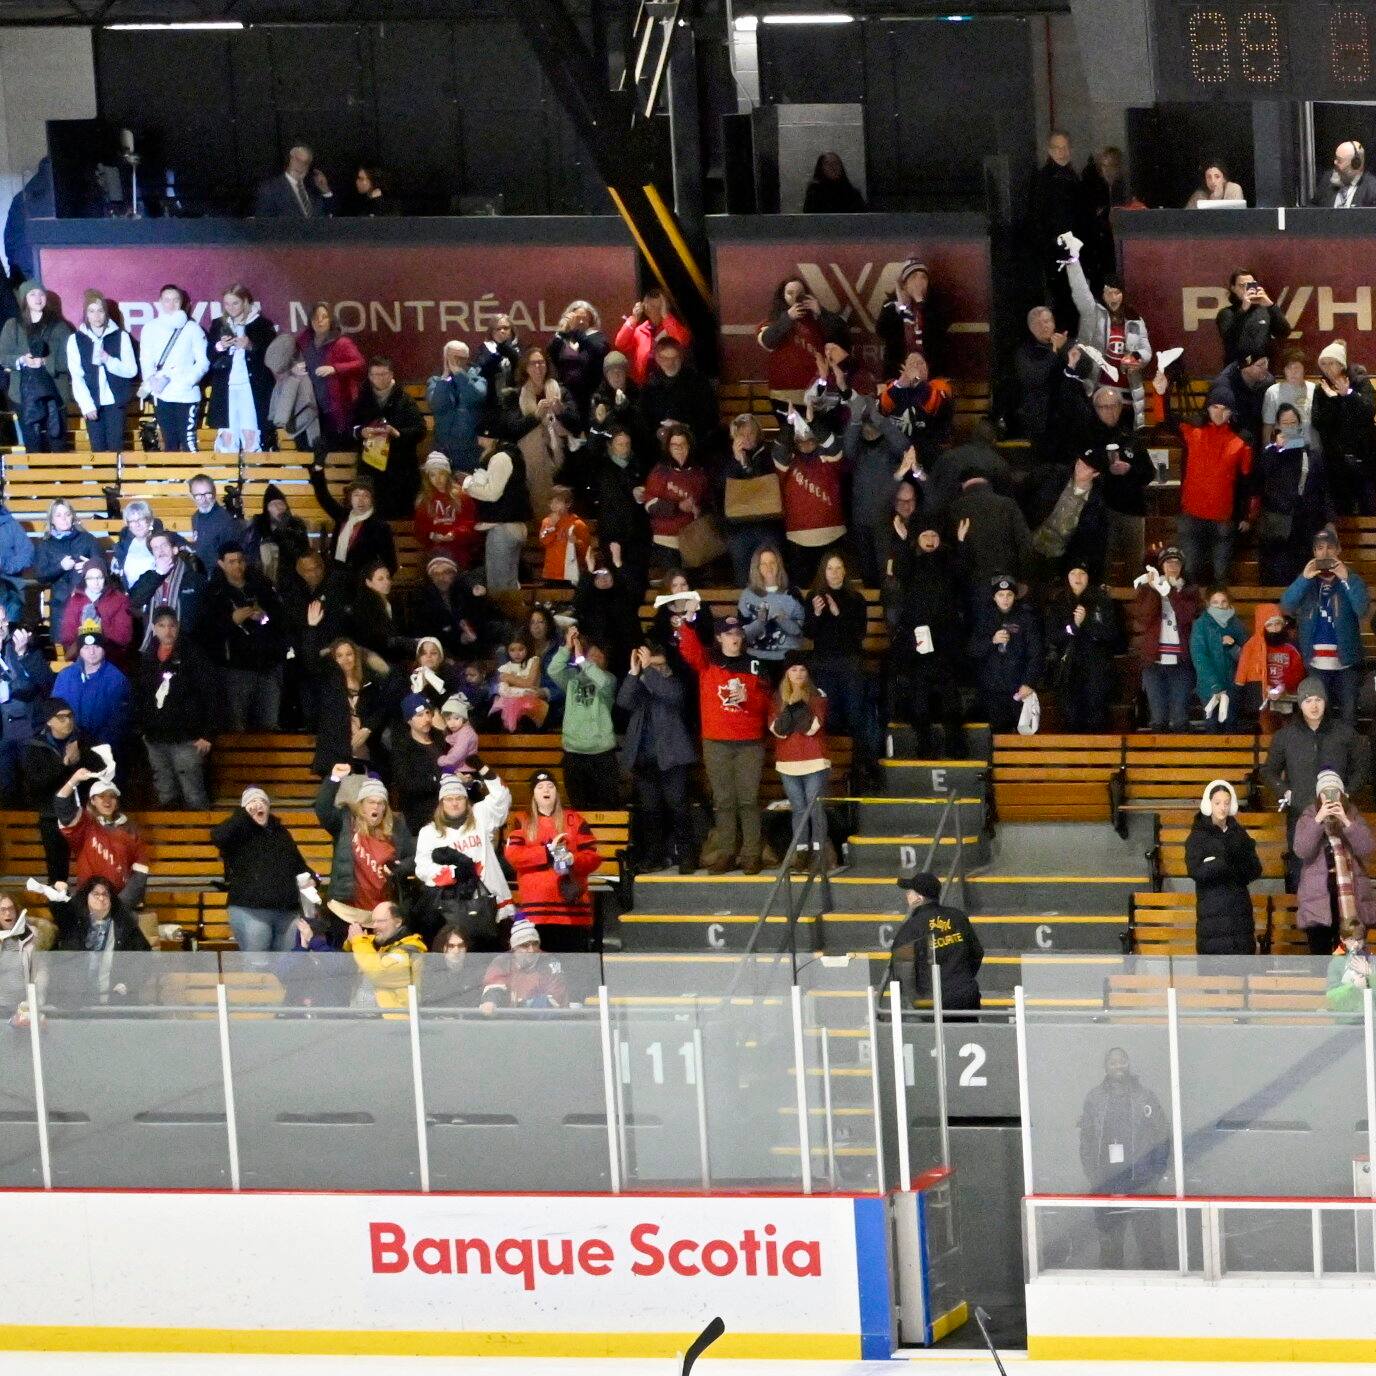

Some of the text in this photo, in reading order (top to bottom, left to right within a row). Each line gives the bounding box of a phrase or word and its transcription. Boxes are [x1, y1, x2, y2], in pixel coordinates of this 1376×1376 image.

[932, 769, 947, 793] E
[901, 845, 917, 869] D
[707, 923, 726, 948] C
[878, 924, 895, 949] C
[1035, 923, 1053, 948] C
[369, 1221, 822, 1291] Banque Scotia
